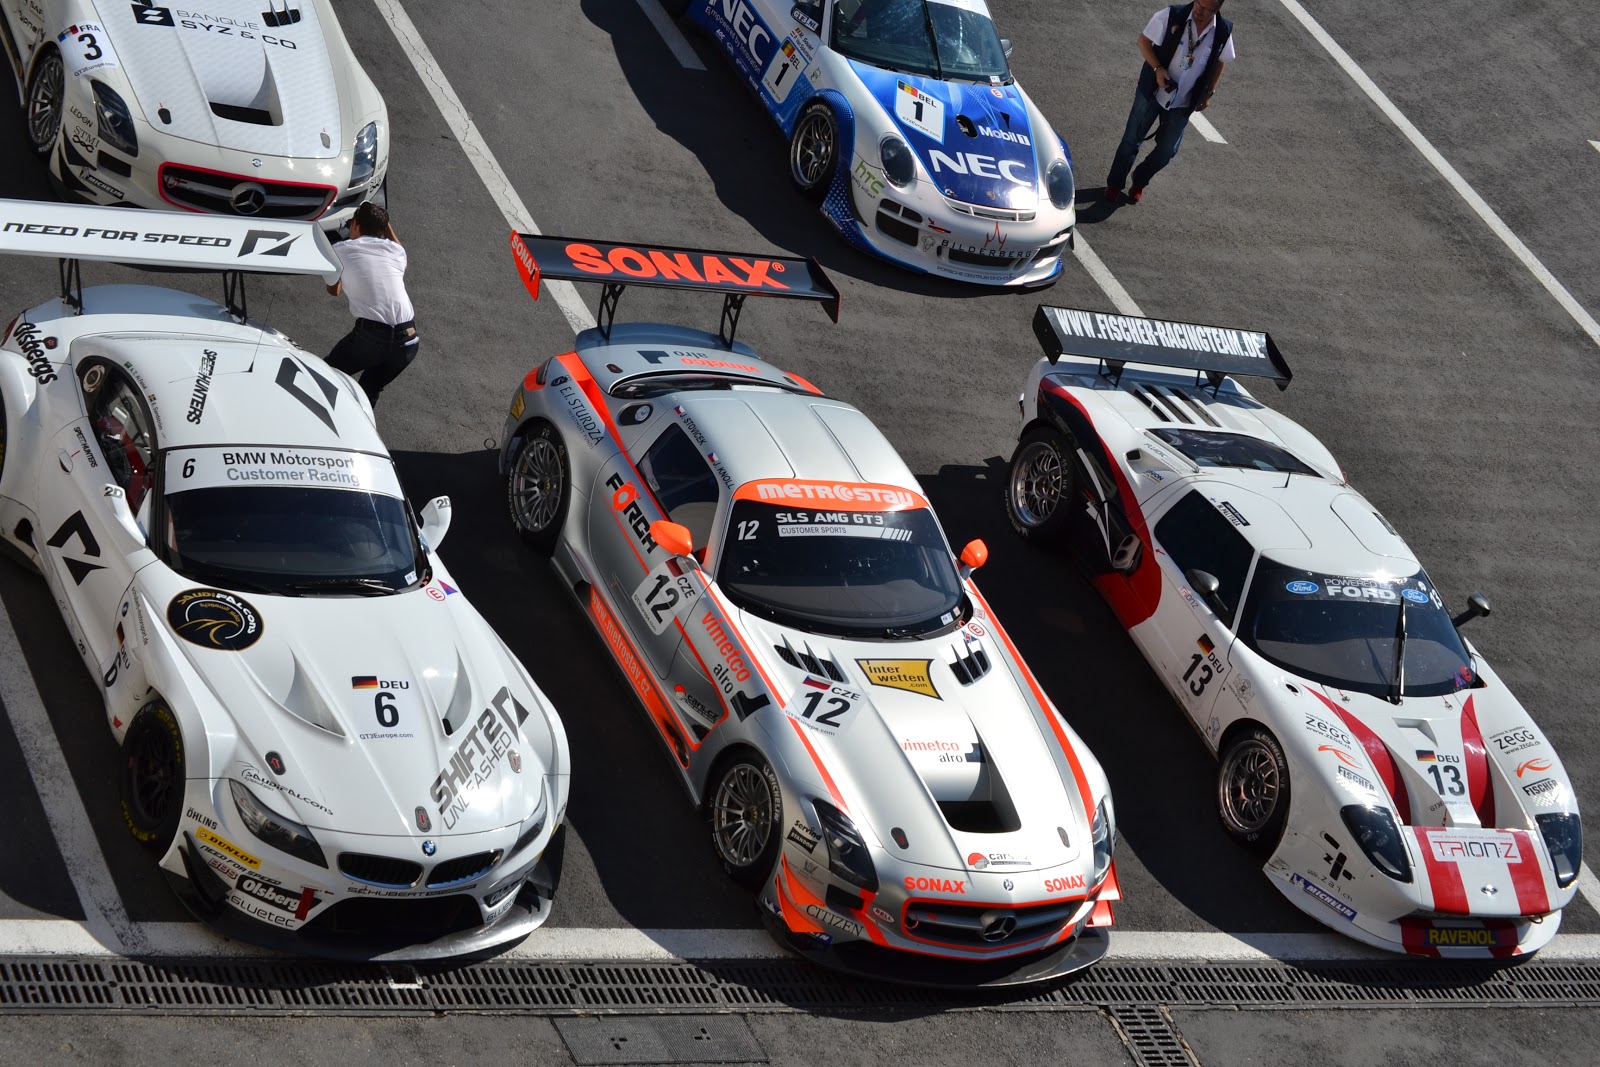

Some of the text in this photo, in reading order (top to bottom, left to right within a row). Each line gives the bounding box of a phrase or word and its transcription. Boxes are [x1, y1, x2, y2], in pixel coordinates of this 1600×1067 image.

[79, 24, 101, 32] FRA
[176, 9, 260, 30] BANQUE
[181, 20, 297, 50] SYZ & CO
[78, 33, 103, 61] 3
[789, 54, 800, 70] BEL
[774, 62, 790, 87] 1
[918, 93, 937, 108] BEL
[913, 101, 923, 122] 1
[978, 125, 1017, 145] Mobil
[928, 149, 1032, 187] NEC
[88, 176, 124, 198] MICHELIN
[3, 222, 232, 248] NEED FOR SPEED
[510, 233, 539, 280] SONAX
[941, 239, 1032, 258] BILDERBERG
[564, 243, 790, 289] SONAX
[1053, 308, 1266, 360] WWW.FISCHER-RACINGTEAM.DE
[681, 356, 763, 373] vimetco
[568, 398, 605, 446] STURDZA
[182, 458, 196, 479] 6
[223, 452, 357, 470] BMW Motorsport
[227, 467, 360, 488] Customer Racing
[716, 466, 735, 490] KNOLL
[104, 486, 123, 498] 2D
[775, 512, 884, 526] SLS AMG GT3
[737, 521, 759, 540] 12
[780, 526, 847, 535] CUSTOMER SPORTS
[676, 576, 697, 599] CZE
[1290, 582, 1314, 593] Ford
[1324, 578, 1378, 588] POWERED
[1326, 586, 1397, 600] FORD
[645, 574, 681, 625] 12
[1404, 590, 1426, 602] Ford
[1429, 589, 1443, 610] 13
[701, 610, 751, 683] vimetco
[104, 651, 121, 687] 6
[868, 660, 900, 675] inter
[1207, 652, 1225, 674] DEU
[379, 680, 410, 690] DEU
[712, 663, 734, 695] alro
[877, 672, 926, 683] wetten
[1182, 653, 1213, 697] 13
[831, 686, 861, 701] CZE
[374, 691, 400, 728] 6
[687, 694, 719, 718] cars.cz
[801, 691, 851, 729] 12
[359, 731, 415, 740] GT3Europe.com
[900, 739, 960, 751] vimetco
[939, 751, 963, 763] alro
[1436, 754, 1460, 764] DEU
[1427, 764, 1466, 797] 13
[767, 773, 782, 823] MICHELIN
[186, 806, 218, 831] ÖHLINS
[789, 830, 815, 850] STANDOX
[208, 836, 259, 866] DUNLOP
[200, 845, 282, 886] NEED FOR SPEED
[208, 858, 239, 880] BBS
[346, 886, 428, 897] SCHUBERT
[904, 876, 965, 894] SONAX
[1044, 875, 1087, 893] SONAX
[1306, 885, 1354, 917] MICHELIN
[806, 904, 865, 937] CITIZEN
[874, 908, 892, 921] BELL
[1429, 928, 1496, 945] RAVENOL
